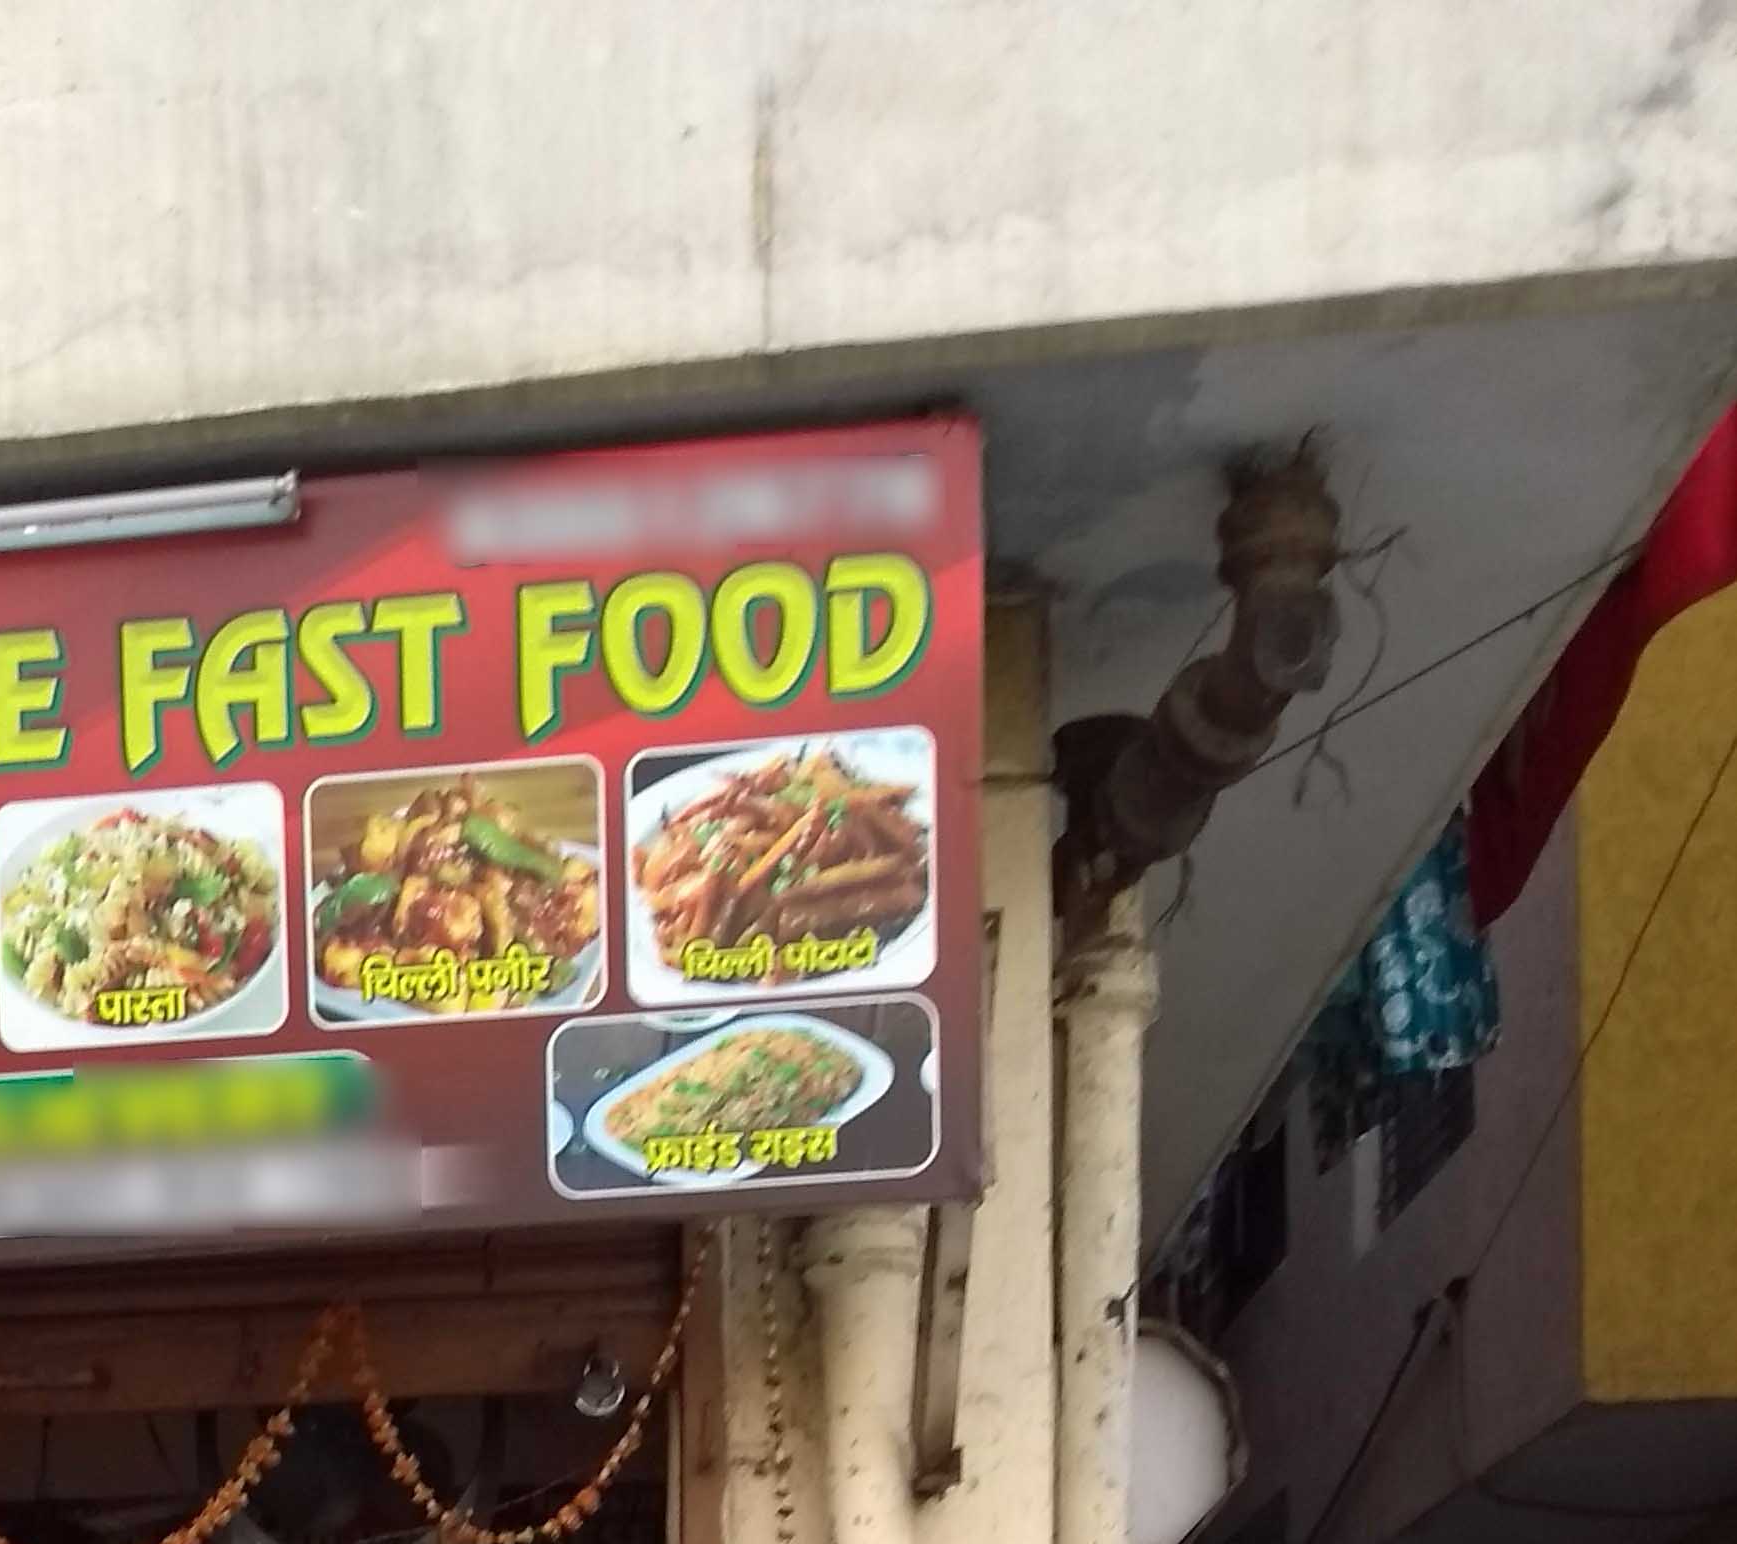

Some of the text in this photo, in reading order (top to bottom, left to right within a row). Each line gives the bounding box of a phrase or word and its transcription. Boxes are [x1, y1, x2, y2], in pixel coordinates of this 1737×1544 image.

[120, 590, 465, 778] FAST
[517, 552, 931, 745] FOOD
[361, 940, 554, 1003] चिल्ली पनीर
[682, 934, 774, 983] चिल्ली
[98, 986, 186, 1027] पास्ता
[748, 1125, 838, 1168] राइस
